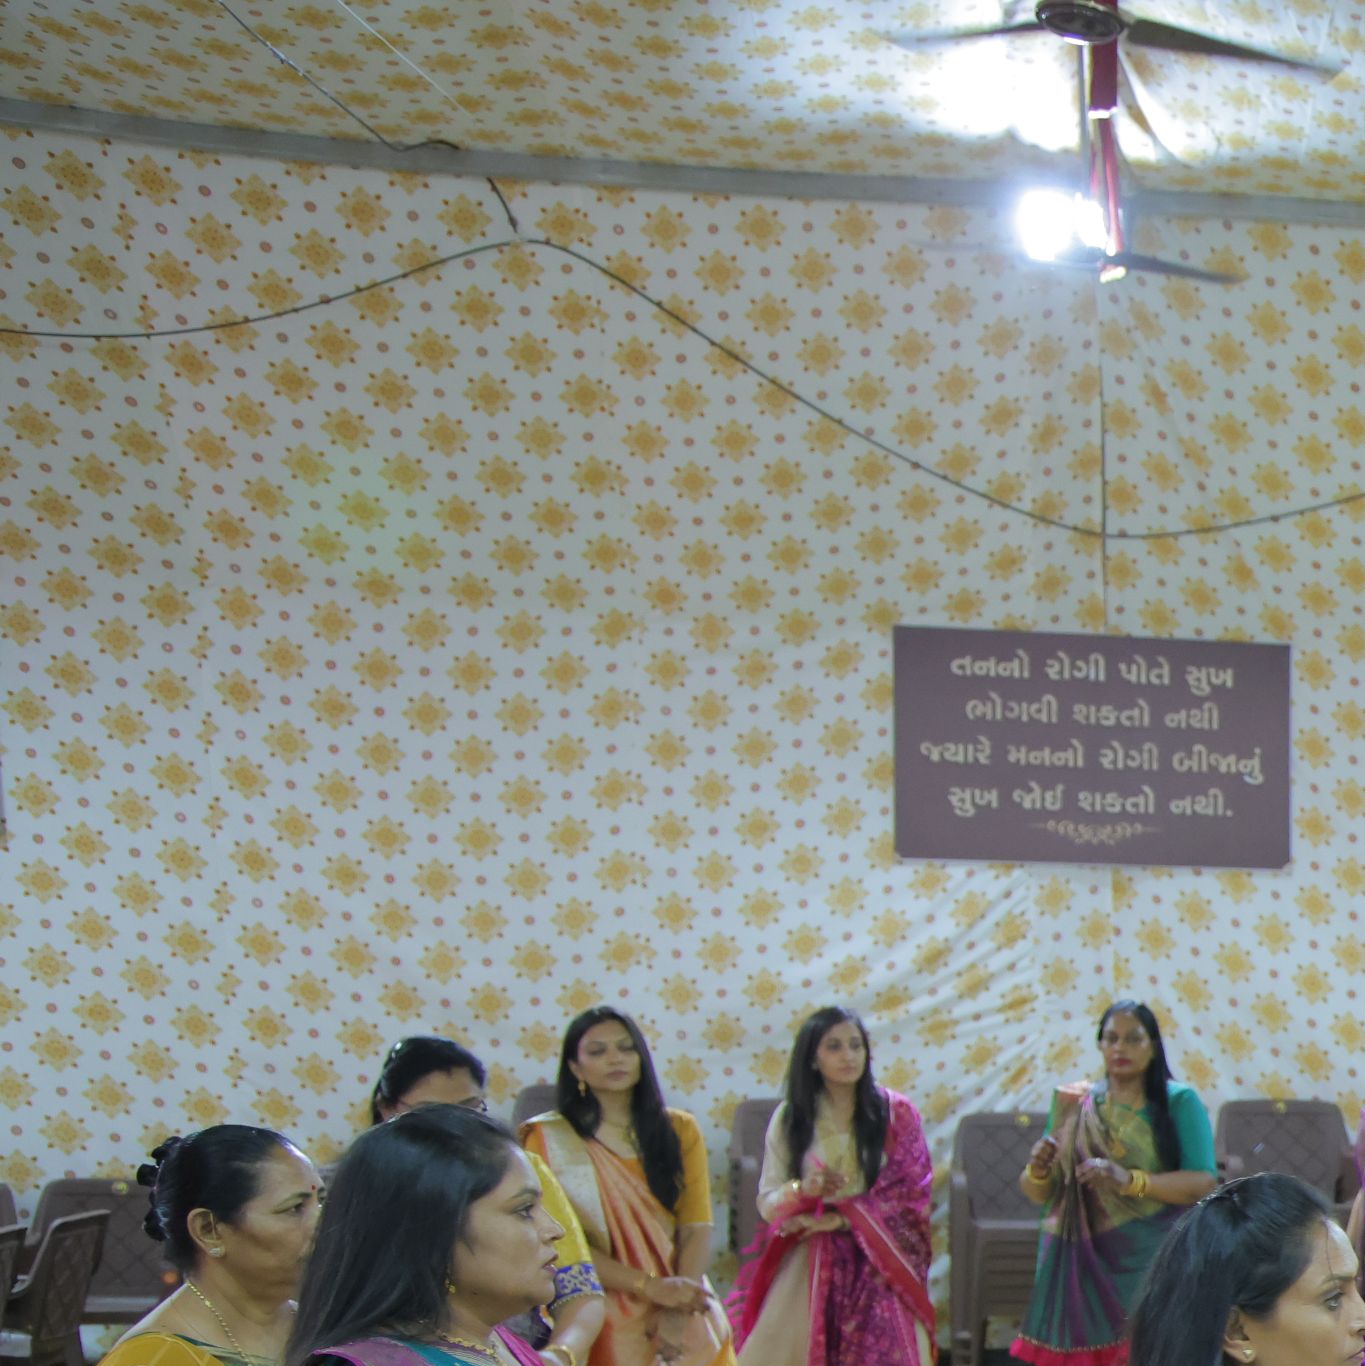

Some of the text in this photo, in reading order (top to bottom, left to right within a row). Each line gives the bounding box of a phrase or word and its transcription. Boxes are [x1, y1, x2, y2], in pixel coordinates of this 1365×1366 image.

[951, 649, 1233, 696] તનનો રોગી પોતે સુખ
[966, 692, 1219, 730] ભોગવી શકતો નથી
[920, 736, 1264, 785] જ્યારે મનનો રોગી બીજાનું
[948, 782, 1232, 817] સુખ જોઈ શકતો નથી.
